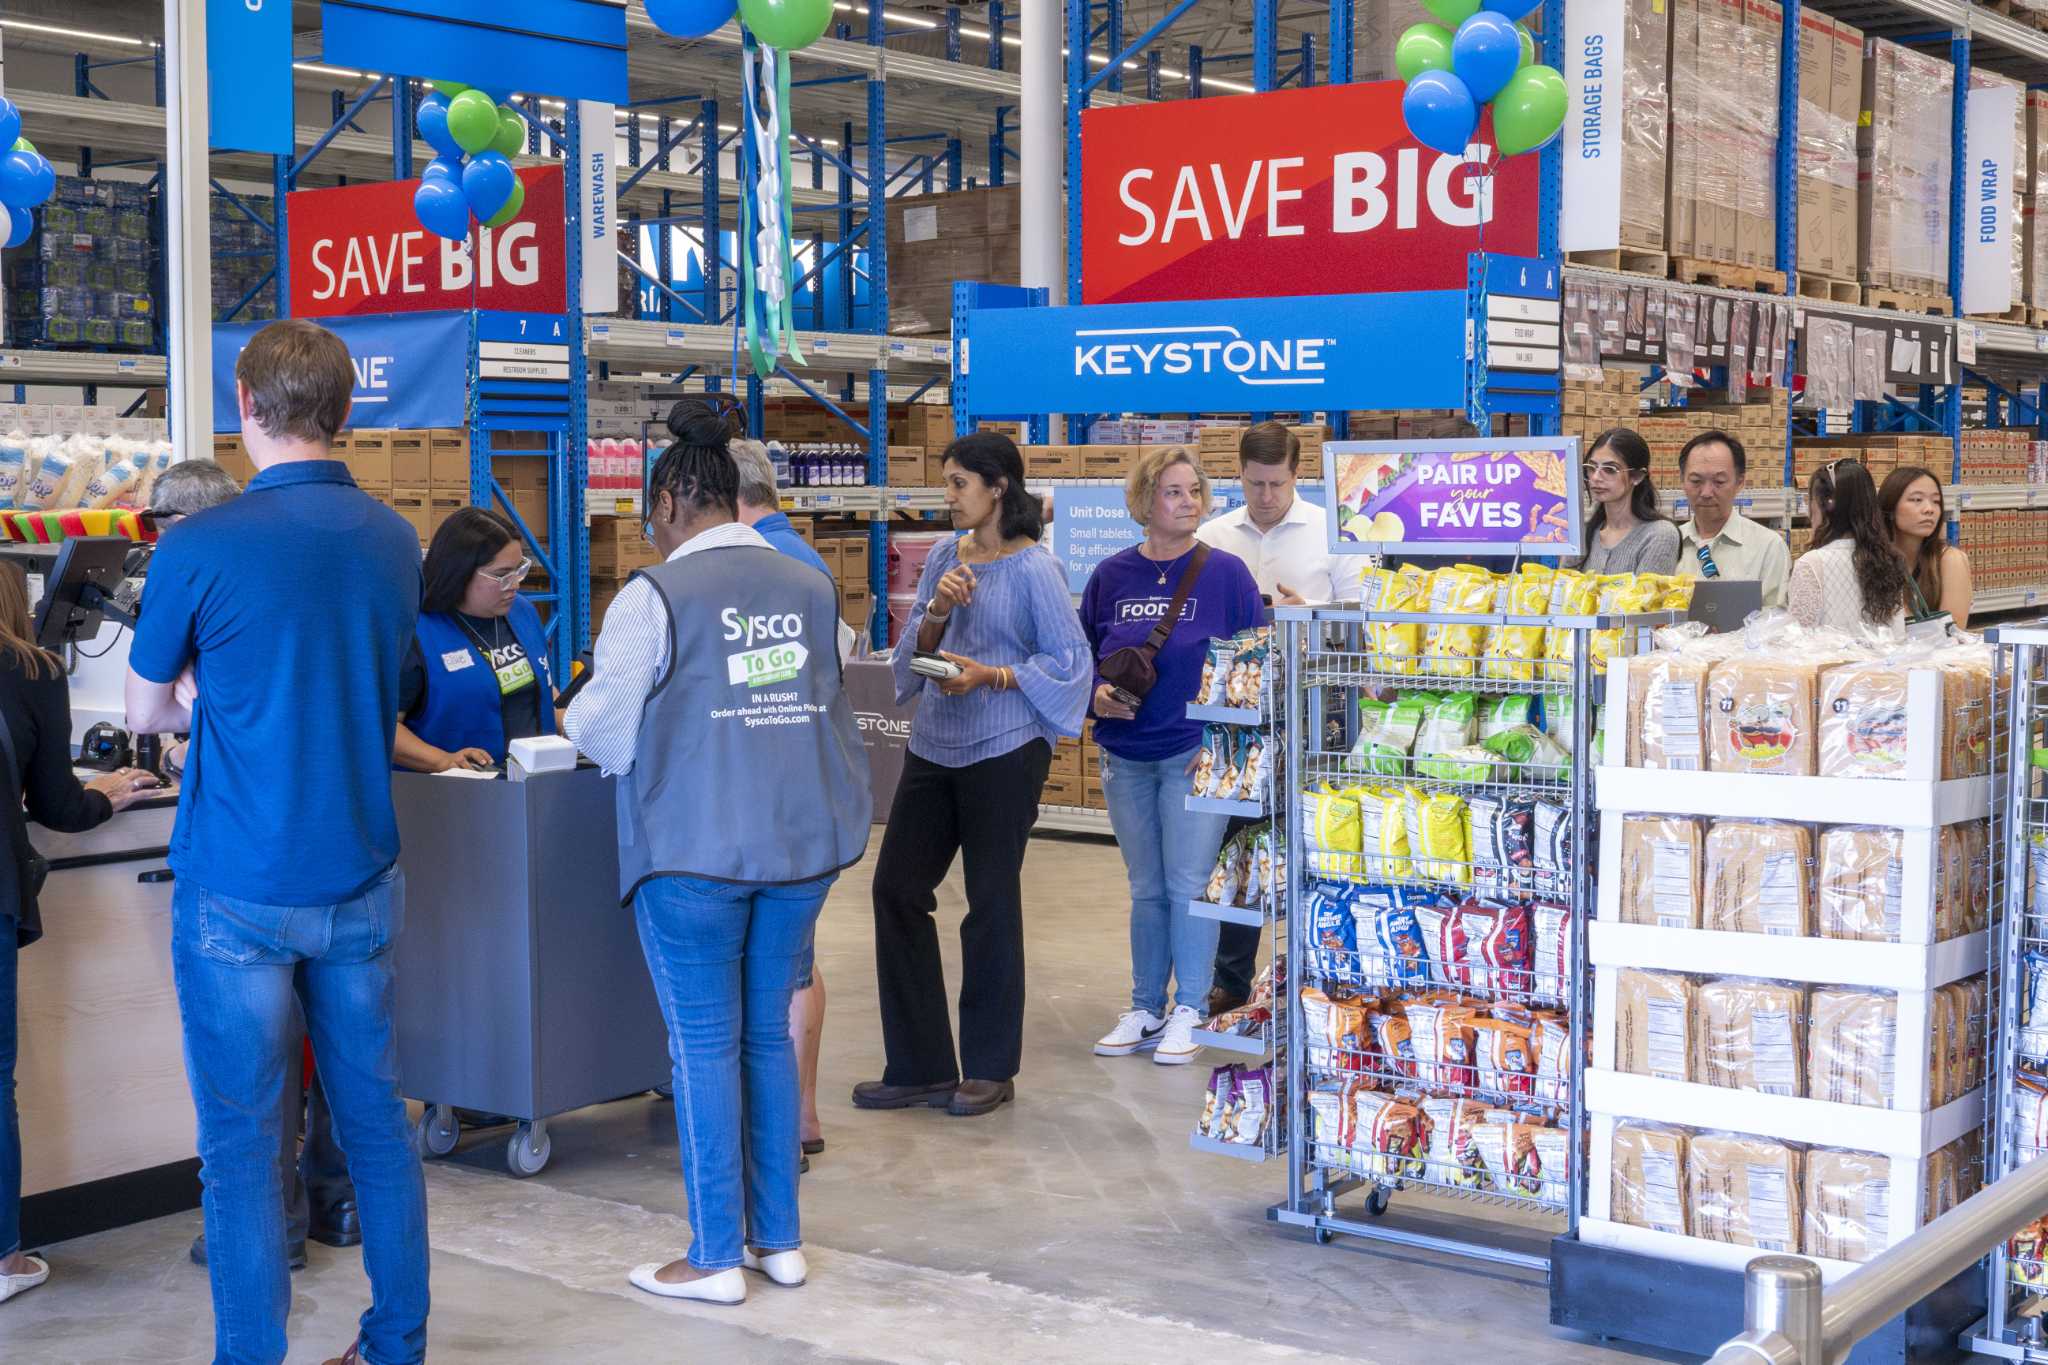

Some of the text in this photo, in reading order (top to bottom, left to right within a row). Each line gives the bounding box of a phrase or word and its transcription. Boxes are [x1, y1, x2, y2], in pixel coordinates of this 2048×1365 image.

[1582, 34, 1604, 159] STORAGE BAGS
[592, 152, 605, 240] WAREWASH
[1117, 143, 1494, 247] SAVE BIG
[1980, 158, 1998, 243] FOOD WRAP
[311, 221, 540, 300] SAVE BIG
[1520, 267, 1553, 290] 6 A
[520, 320, 561, 337] 7 A
[1418, 463, 1521, 485] PAIR UP
[1070, 506, 1093, 518] Unit
[1095, 506, 1125, 518] Dose
[1450, 488, 1495, 514] your
[1419, 502, 1523, 528] FAVES
[1070, 528, 1096, 538] Small
[1070, 544, 1086, 558] Big
[1070, 560, 1082, 571] for
[721, 607, 803, 647] Sysco
[742, 648, 797, 673] To Go
[752, 692, 798, 703] IN A RUSH?
[711, 709, 735, 719] Order
[737, 707, 761, 716] ahead
[762, 706, 778, 714] with
[778, 704, 802, 713] Online
[744, 715, 810, 728] SyscoToGo.com
[856, 717, 911, 733] STONE
